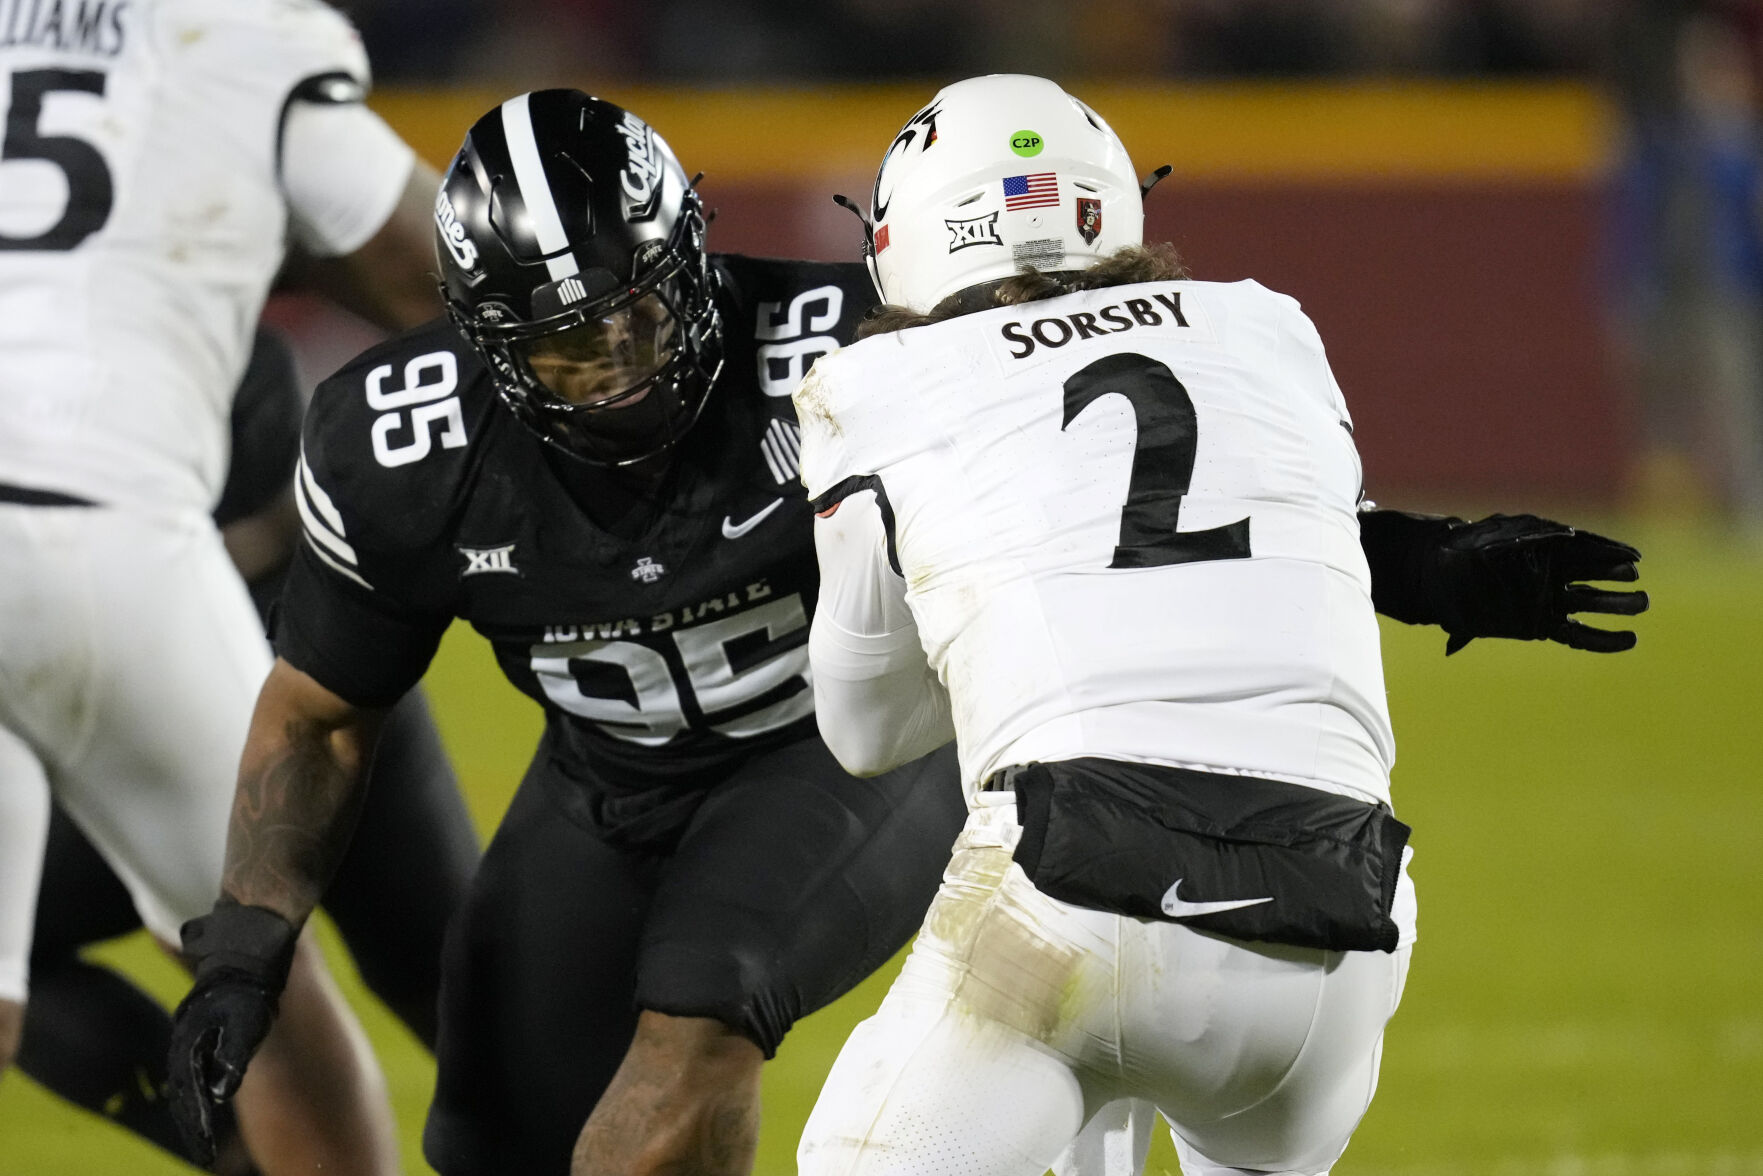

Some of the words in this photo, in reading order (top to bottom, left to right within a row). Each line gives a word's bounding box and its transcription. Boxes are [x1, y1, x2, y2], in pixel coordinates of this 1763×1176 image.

[0, 68, 115, 252] 5
[1012, 137, 1040, 149] C2P
[755, 285, 844, 398] 95
[1001, 292, 1191, 359] SORSBY
[365, 350, 468, 468] 95
[1061, 352, 1252, 568] 2
[529, 592, 814, 747] 95
